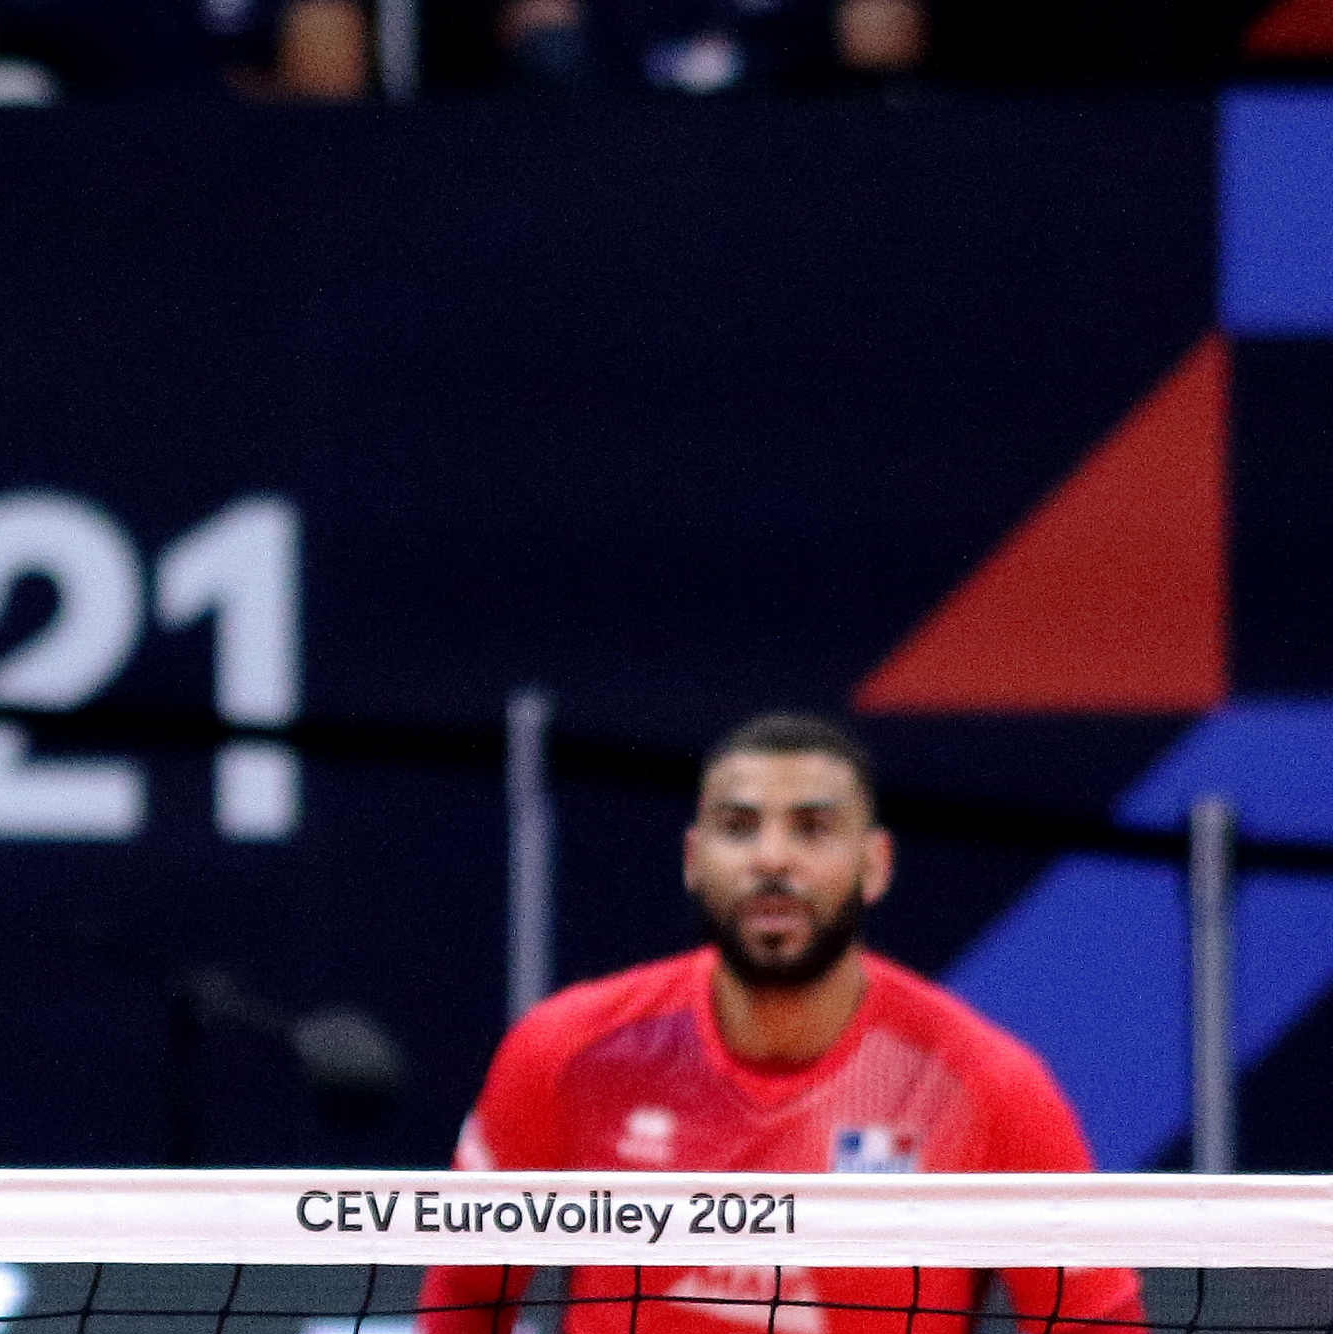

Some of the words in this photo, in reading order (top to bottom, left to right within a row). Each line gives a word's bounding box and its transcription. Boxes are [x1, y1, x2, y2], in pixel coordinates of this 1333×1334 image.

[296, 1190, 400, 1232] CEV
[415, 1191, 675, 1244] EuroVolley
[688, 1193, 796, 1234] 2021
